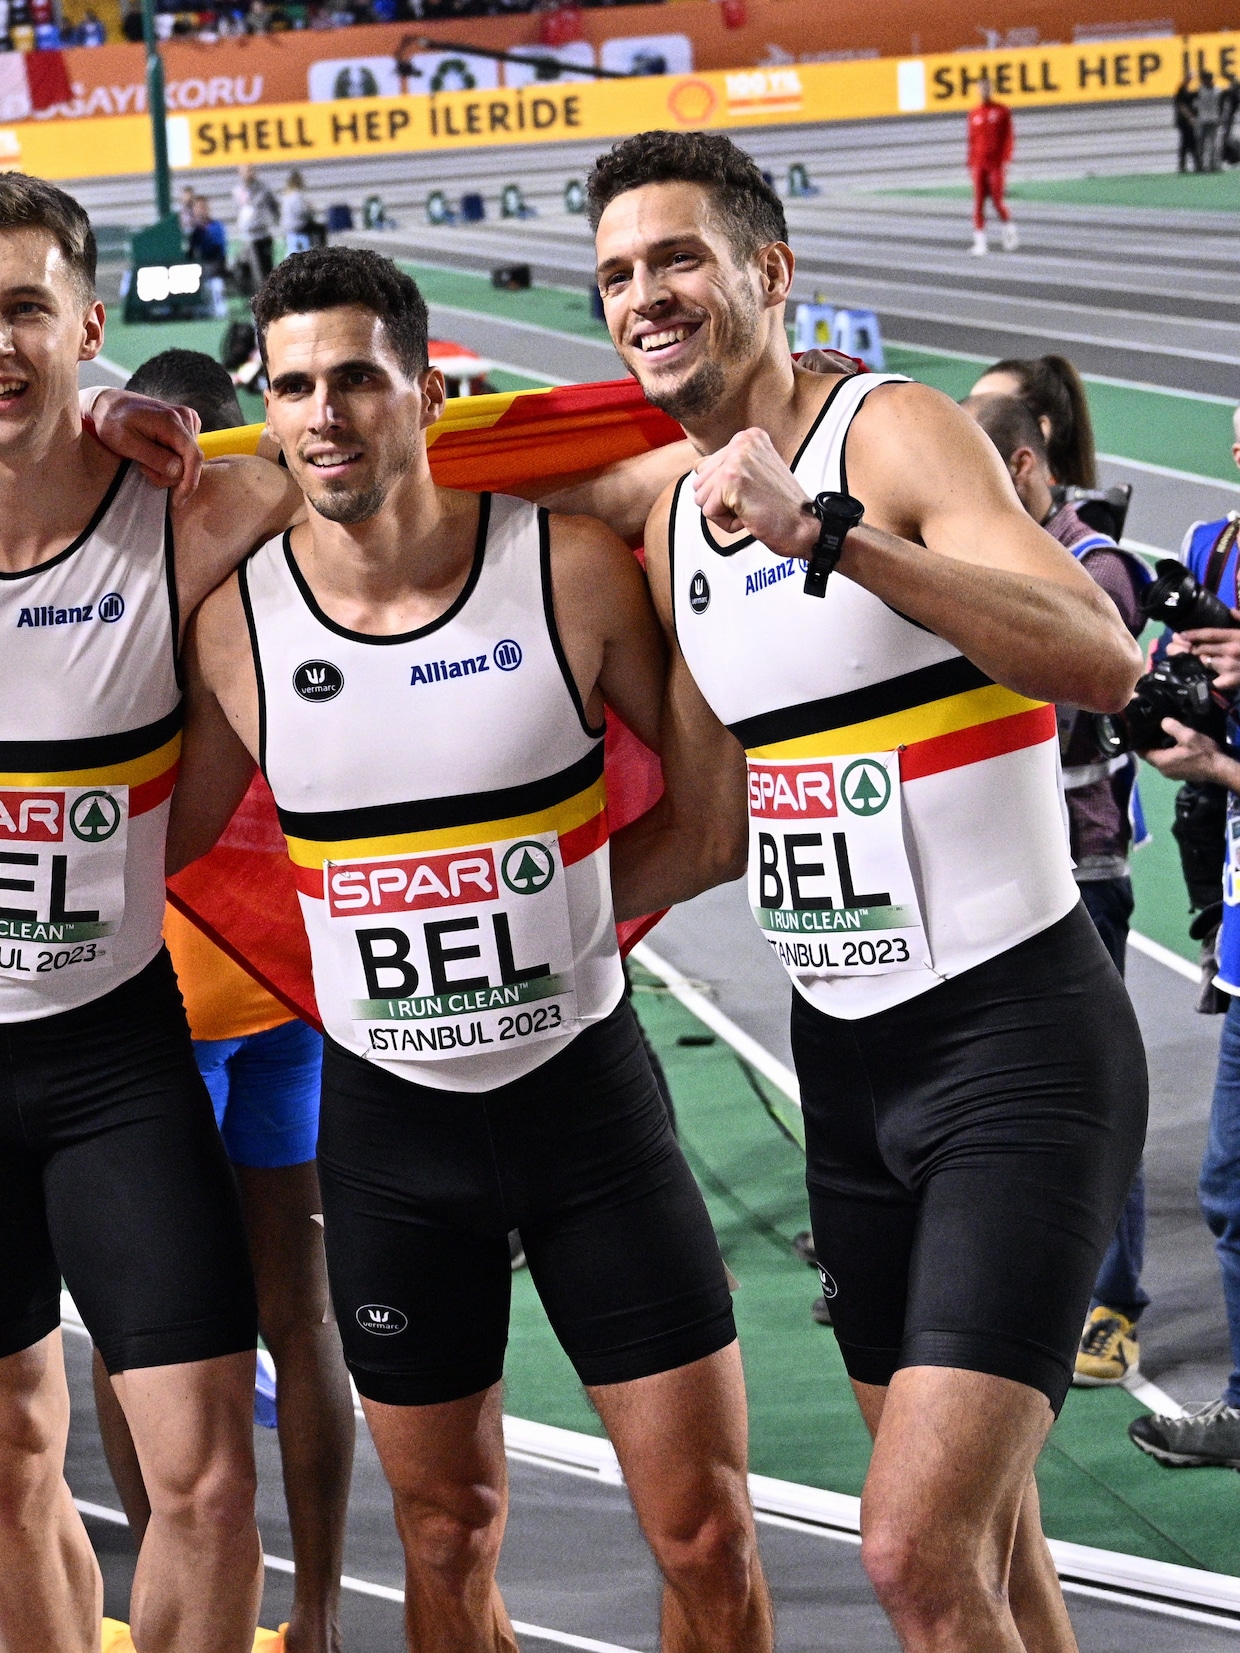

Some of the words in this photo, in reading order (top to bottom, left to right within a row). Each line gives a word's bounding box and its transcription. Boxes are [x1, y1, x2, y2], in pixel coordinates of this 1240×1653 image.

[933, 61, 1059, 99] SHELL
[1078, 52, 1162, 89] HEP
[198, 116, 313, 156] SHELL
[331, 109, 411, 143] HEP
[430, 88, 582, 138] İLERİDE
[746, 557, 795, 596] Allianz
[17, 603, 93, 628] Allianz
[410, 655, 490, 686] Allianz
[301, 683, 337, 695] vermarc
[750, 771, 833, 811] SPAR
[331, 859, 493, 909] SPAR
[759, 832, 892, 910] BEL
[769, 912, 774, 928] I
[776, 912, 799, 929] RUN
[36, 943, 97, 973] 2023
[355, 912, 551, 1000] BEL
[843, 938, 909, 967] 2023
[388, 1002, 395, 1017] I
[398, 998, 443, 1017] RUN
[368, 1018, 493, 1053] ISTANBUL
[498, 1005, 562, 1042] 2023
[362, 1321, 400, 1330] vermarc
